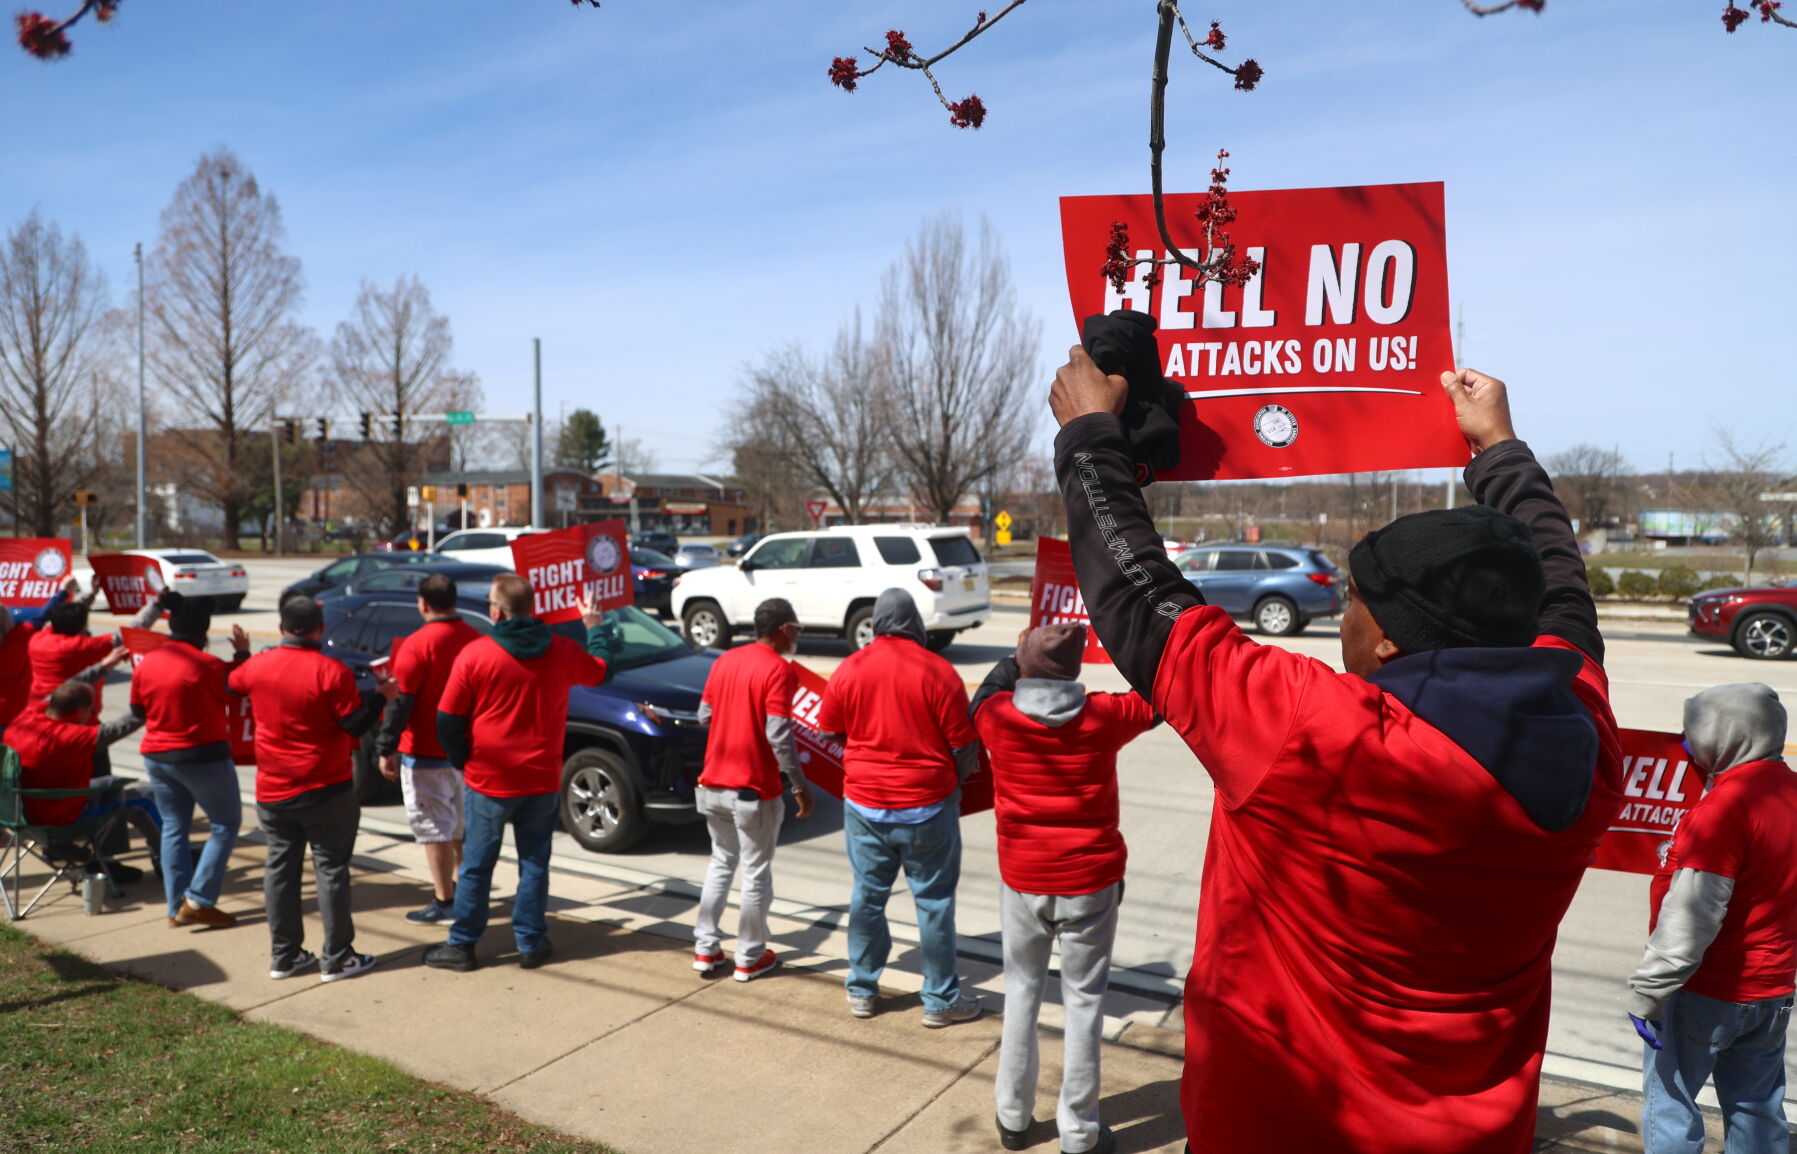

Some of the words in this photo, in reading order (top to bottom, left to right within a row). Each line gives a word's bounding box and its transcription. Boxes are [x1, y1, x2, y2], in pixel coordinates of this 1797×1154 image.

[1104, 246, 1277, 330] HELL
[1305, 240, 1417, 326] NO
[1165, 338, 1302, 378] ATTACKS
[1312, 338, 1357, 374] ON
[1368, 335, 1418, 372] US!
[1074, 452, 1153, 586] COMPETITION
[0, 562, 33, 580] GHT
[108, 576, 146, 592] FIGHT
[528, 558, 585, 590] FIGHT
[113, 592, 143, 609] LIKE
[534, 585, 577, 615] LIKE
[1618, 803, 1689, 826] ATTACK
